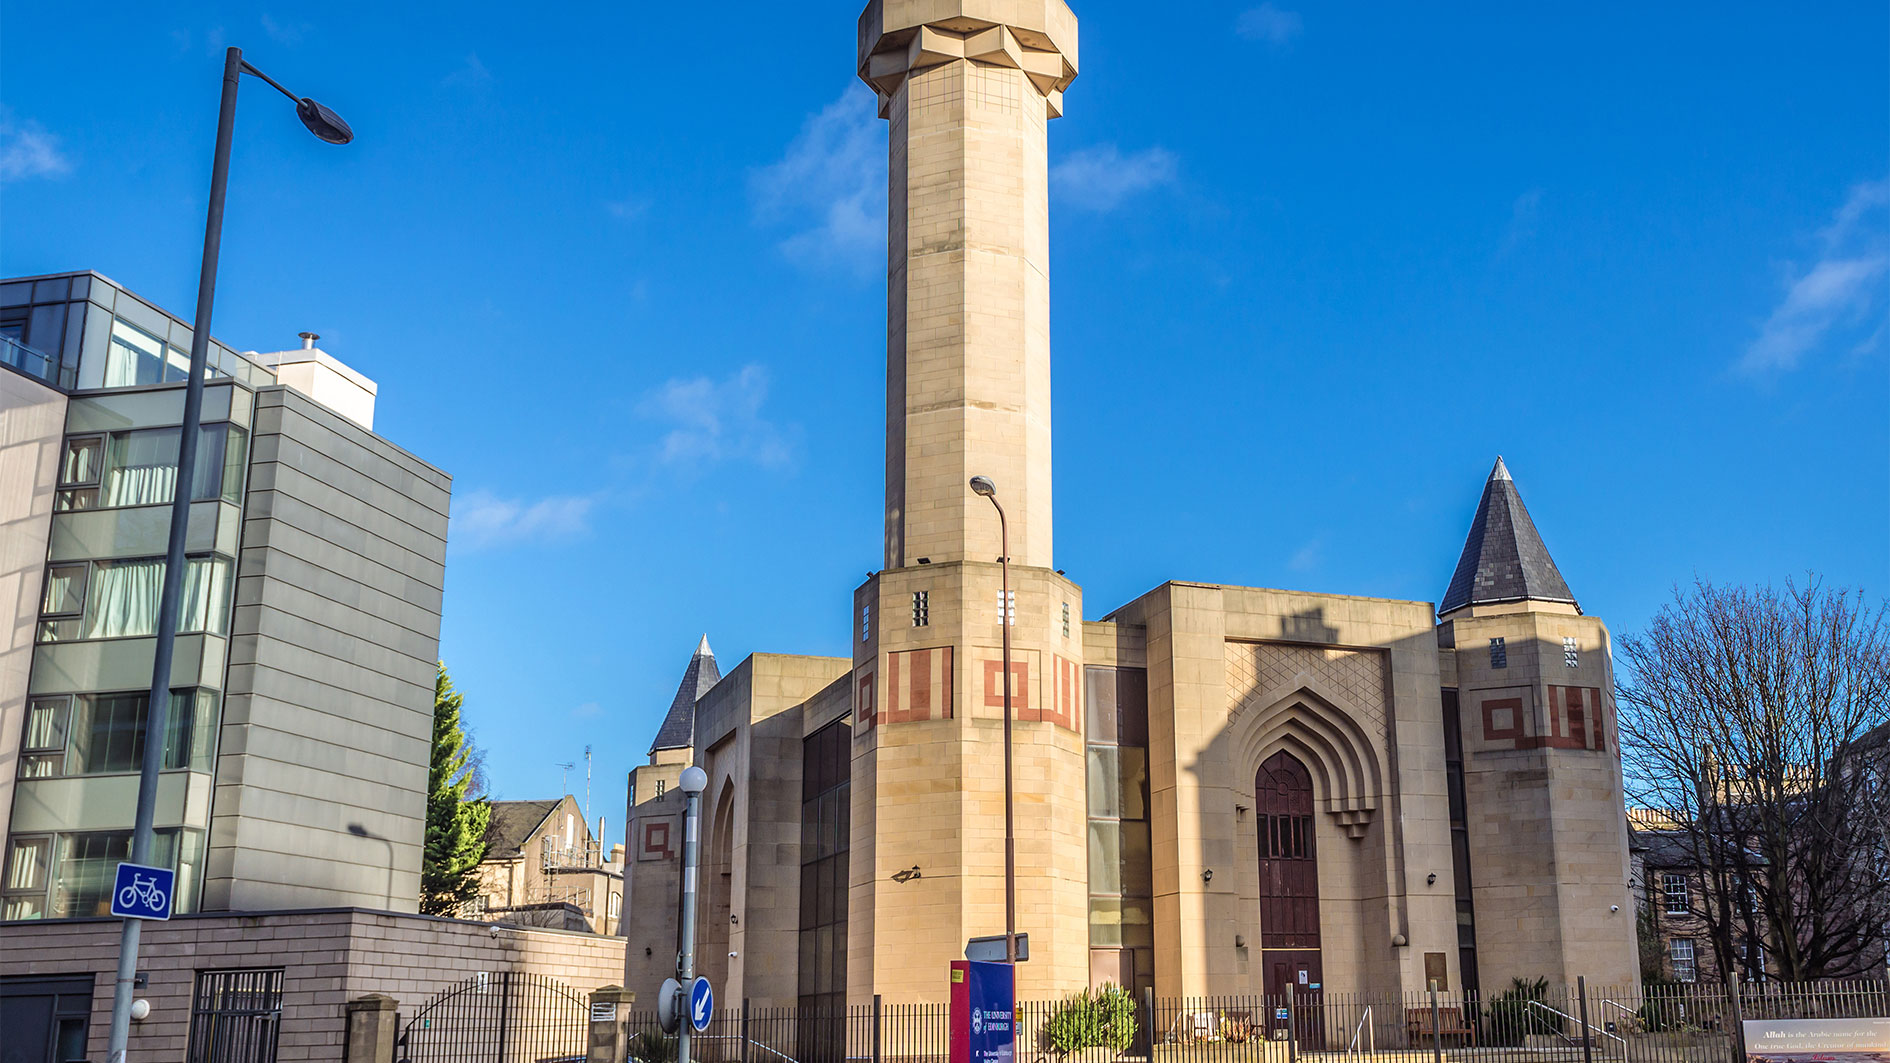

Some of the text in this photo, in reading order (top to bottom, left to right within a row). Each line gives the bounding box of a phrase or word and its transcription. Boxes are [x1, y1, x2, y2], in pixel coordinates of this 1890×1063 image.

[991, 1011, 1012, 1019] UNIVERSITY
[988, 1023, 1009, 1031] EDINBURGH
[1763, 1031, 1786, 1039] Allah
[1853, 1030, 1865, 1039] for
[1846, 1042, 1855, 1050] of
